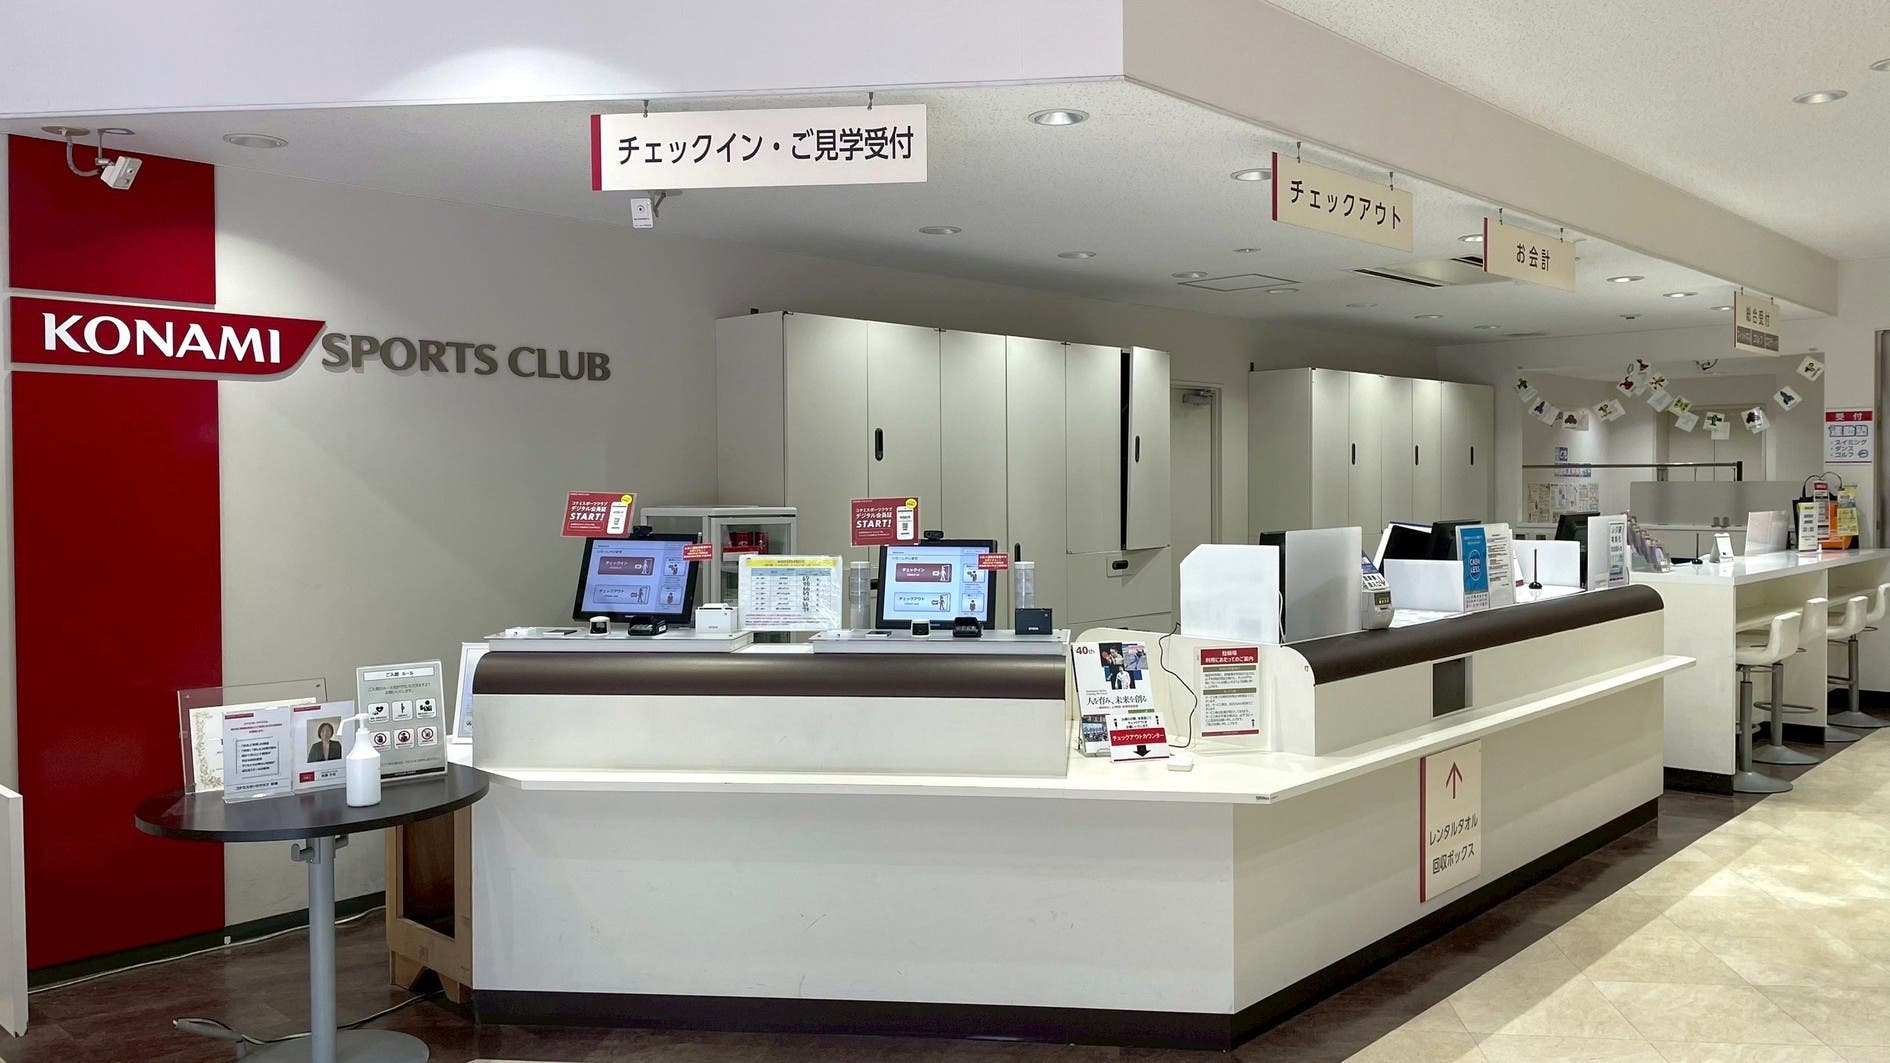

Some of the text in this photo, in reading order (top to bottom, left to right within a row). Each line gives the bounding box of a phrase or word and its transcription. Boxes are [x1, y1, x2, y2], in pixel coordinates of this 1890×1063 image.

[618, 125, 914, 166] チェックイン・ご見学受付
[1290, 179, 1401, 230] チェックアウト
[1516, 242, 1551, 272] お会計
[42, 312, 281, 364] KONAMI
[321, 332, 612, 382] SPORTS CLUB
[569, 512, 606, 521] START!
[856, 519, 892, 528] START!
[1076, 646, 1096, 655] 40th
[1112, 733, 1165, 742] チェックアウトカウンター
[1429, 813, 1479, 846] レンタルタオル
[1432, 843, 1475, 875] 回収ボックス
